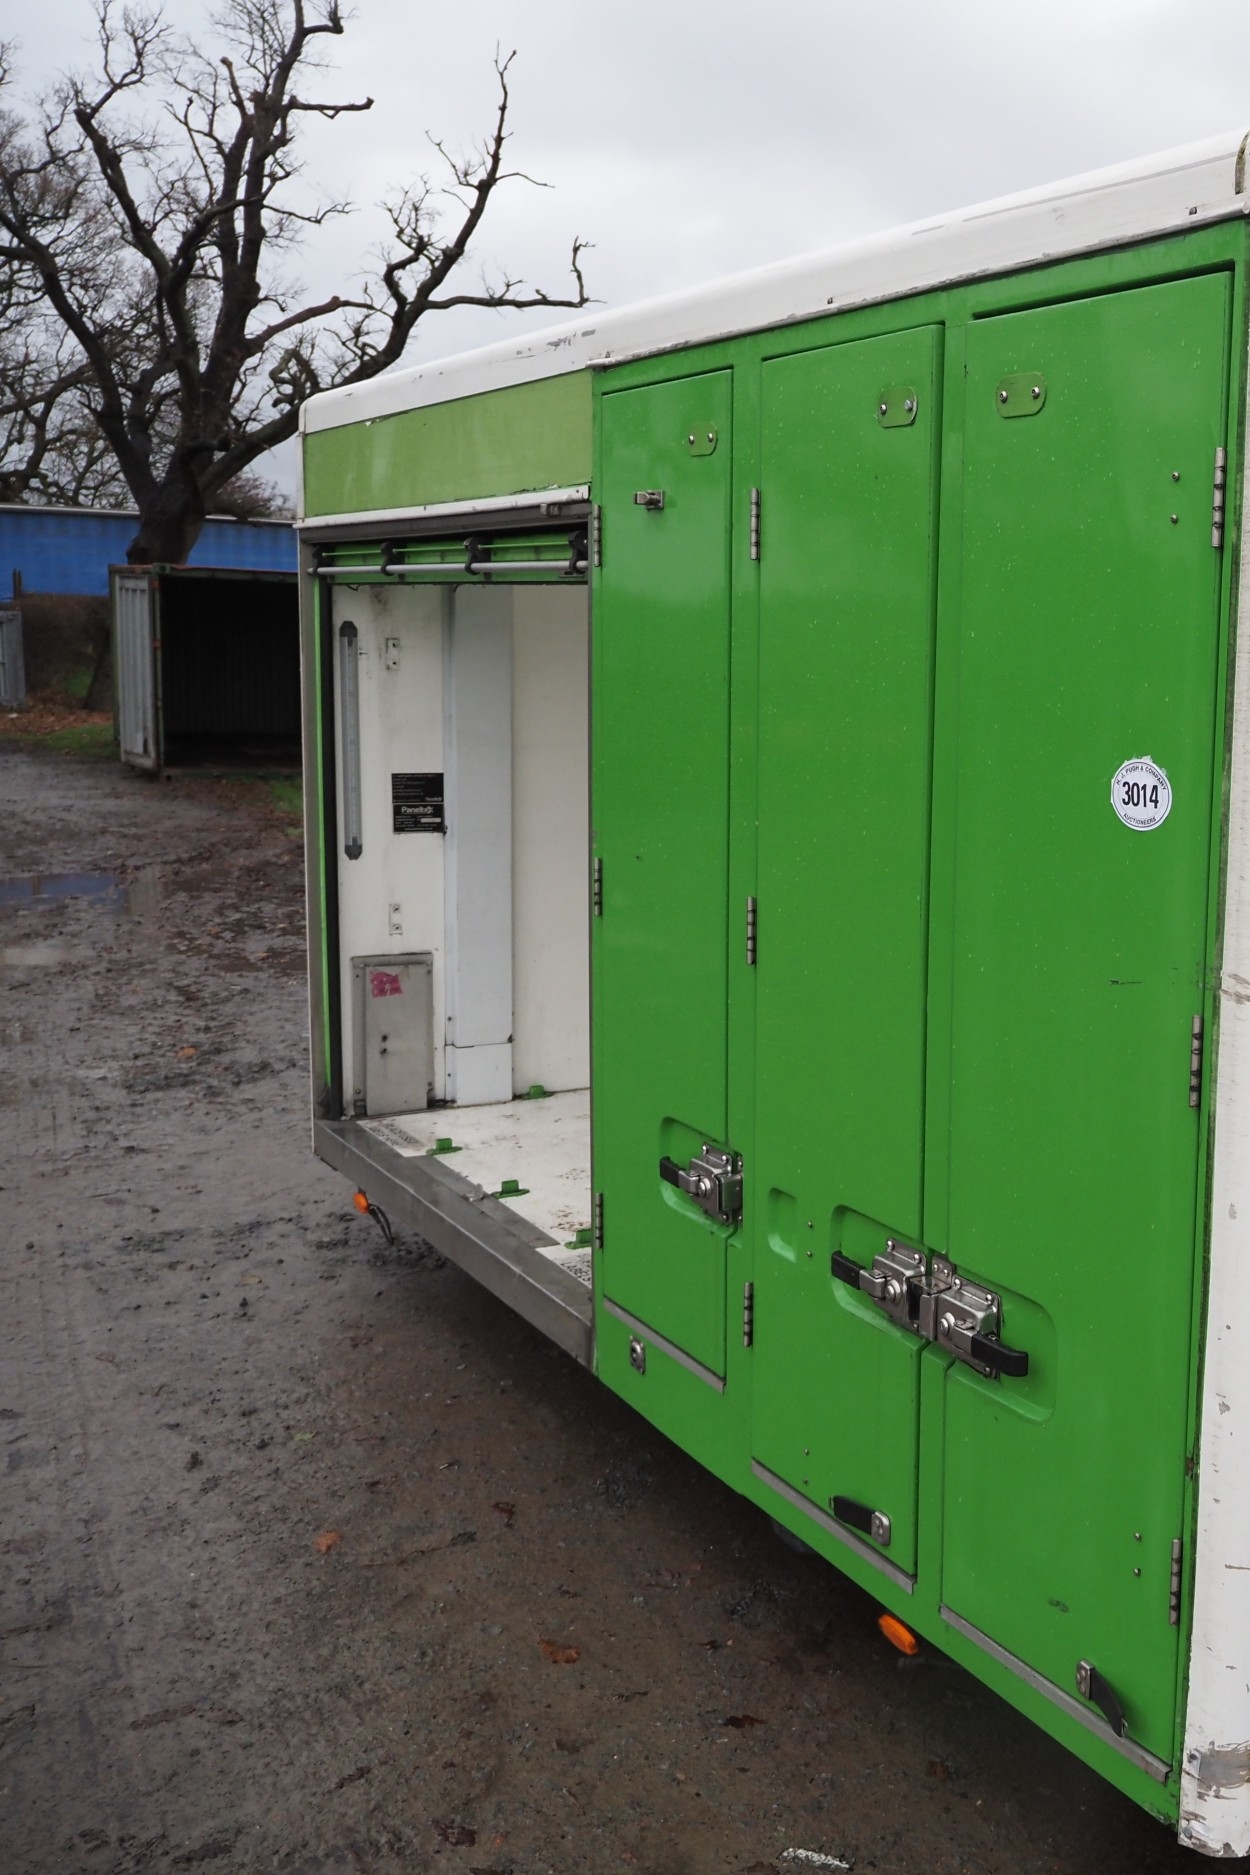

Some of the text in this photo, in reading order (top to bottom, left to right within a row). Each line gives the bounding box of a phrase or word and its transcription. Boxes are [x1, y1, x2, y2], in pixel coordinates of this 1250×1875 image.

[1125, 765, 1140, 774] PUGH
[1145, 766, 1167, 790] COMPANY
[1122, 781, 1159, 809] 3014
[1123, 813, 1157, 825] AUCTIONEERS
